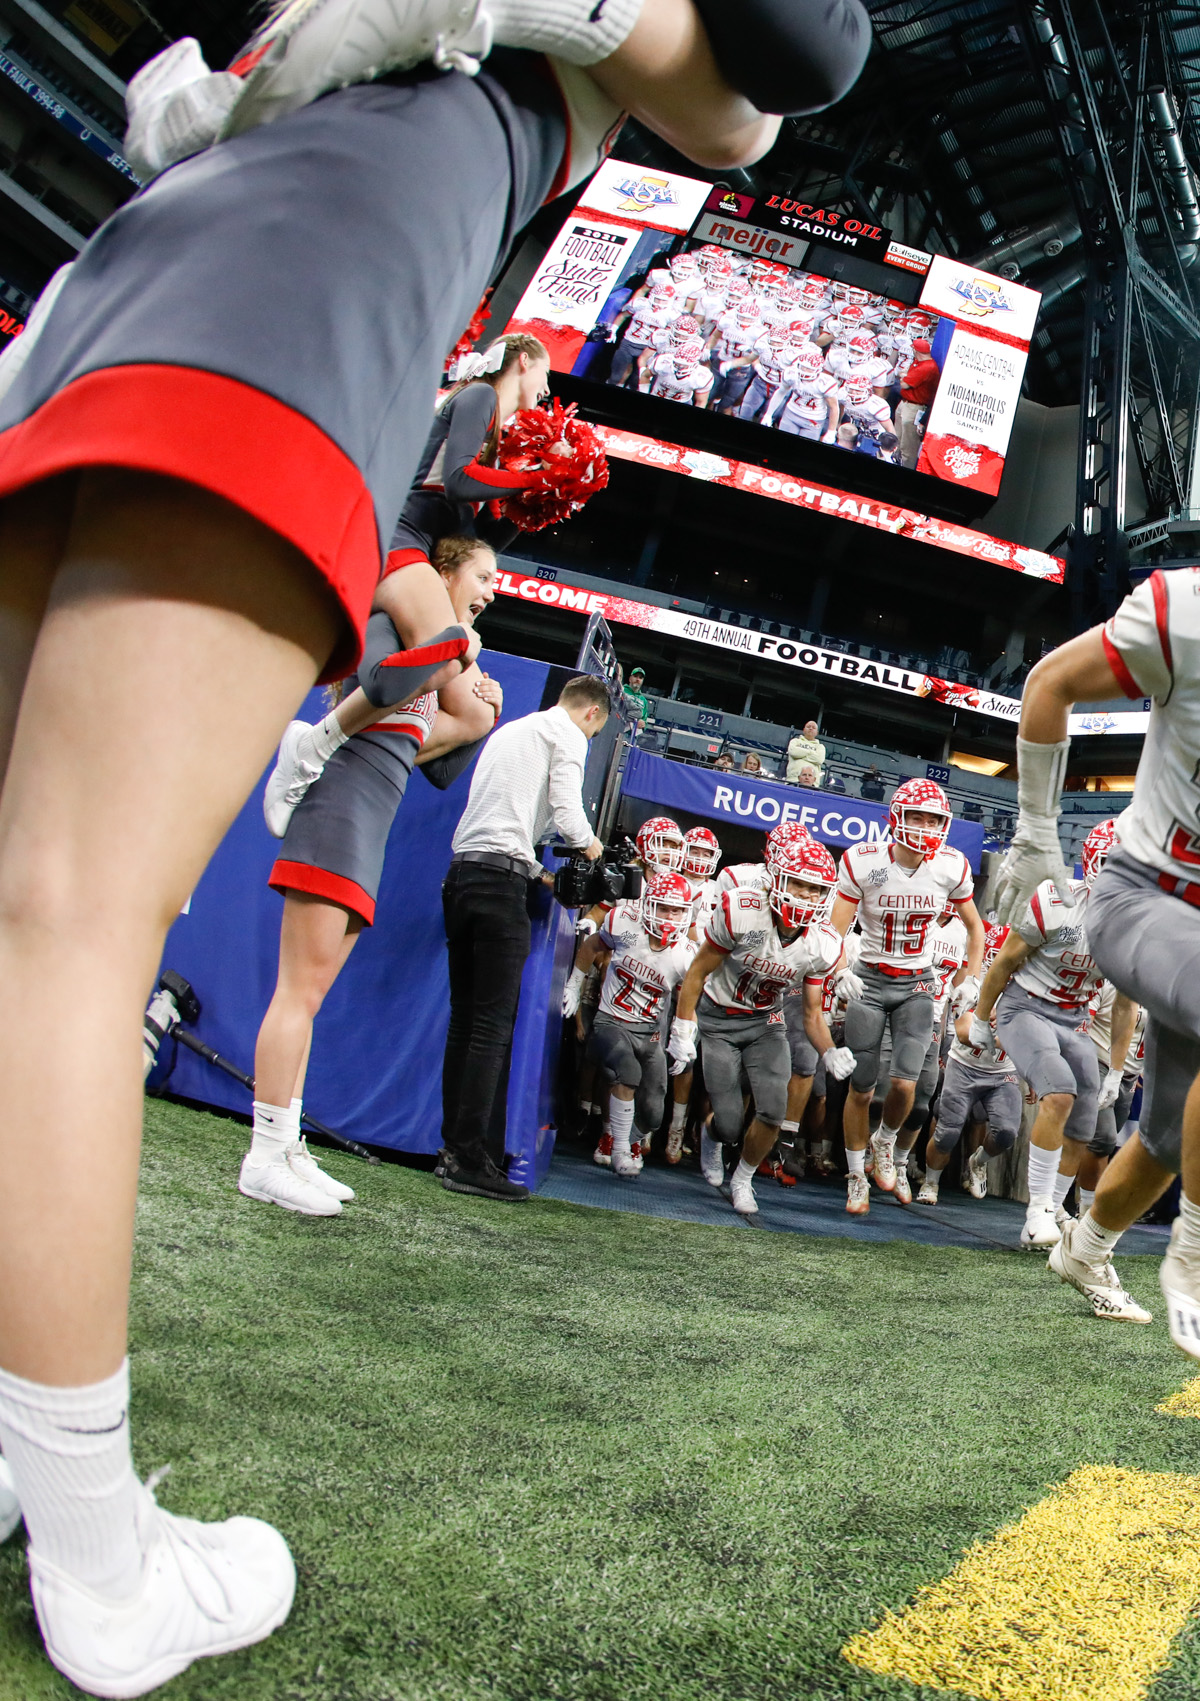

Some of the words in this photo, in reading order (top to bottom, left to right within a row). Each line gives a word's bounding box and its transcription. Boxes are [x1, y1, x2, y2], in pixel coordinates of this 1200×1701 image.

[7, 66, 34, 94] FAULK
[32, 87, 65, 119] 1994-98
[107, 152, 132, 177] JEFF
[765, 195, 841, 226] LUCAS
[843, 219, 882, 241] OIL
[780, 216, 858, 247] STADIUM
[583, 229, 617, 242] 2021
[708, 221, 795, 257] meijer
[559, 236, 623, 267] FOOTBALL
[886, 254, 906, 267] EVENT
[905, 260, 926, 272] GROUP
[545, 259, 613, 283] State
[538, 275, 602, 304] Finals
[954, 344, 982, 366] ADAMS
[982, 353, 1015, 378] CENTRAL
[960, 361, 986, 375] FLYING
[987, 370, 1006, 381] JETS
[947, 382, 1007, 415] INDIANAPOLIS
[950, 400, 996, 427] LUTHERAN
[956, 419, 984, 433] SAINTS
[742, 470, 898, 530] FOOTBALL
[537, 569, 555, 581] 320
[492, 573, 608, 615] ELCOME
[682, 619, 711, 639] 49TH
[711, 625, 752, 651] ANNUAL
[757, 637, 917, 691] FOOTBALL
[982, 696, 1021, 717] State
[699, 714, 720, 728] 221
[928, 767, 948, 781] 222
[878, 894, 937, 908] CENTRAL
[880, 909, 937, 957] 19
[622, 954, 665, 986] CENTRAL
[743, 953, 798, 981] CENTRAL
[611, 965, 665, 1019] 27
[914, 981, 936, 993] AC
[767, 1011, 785, 1025] AC
